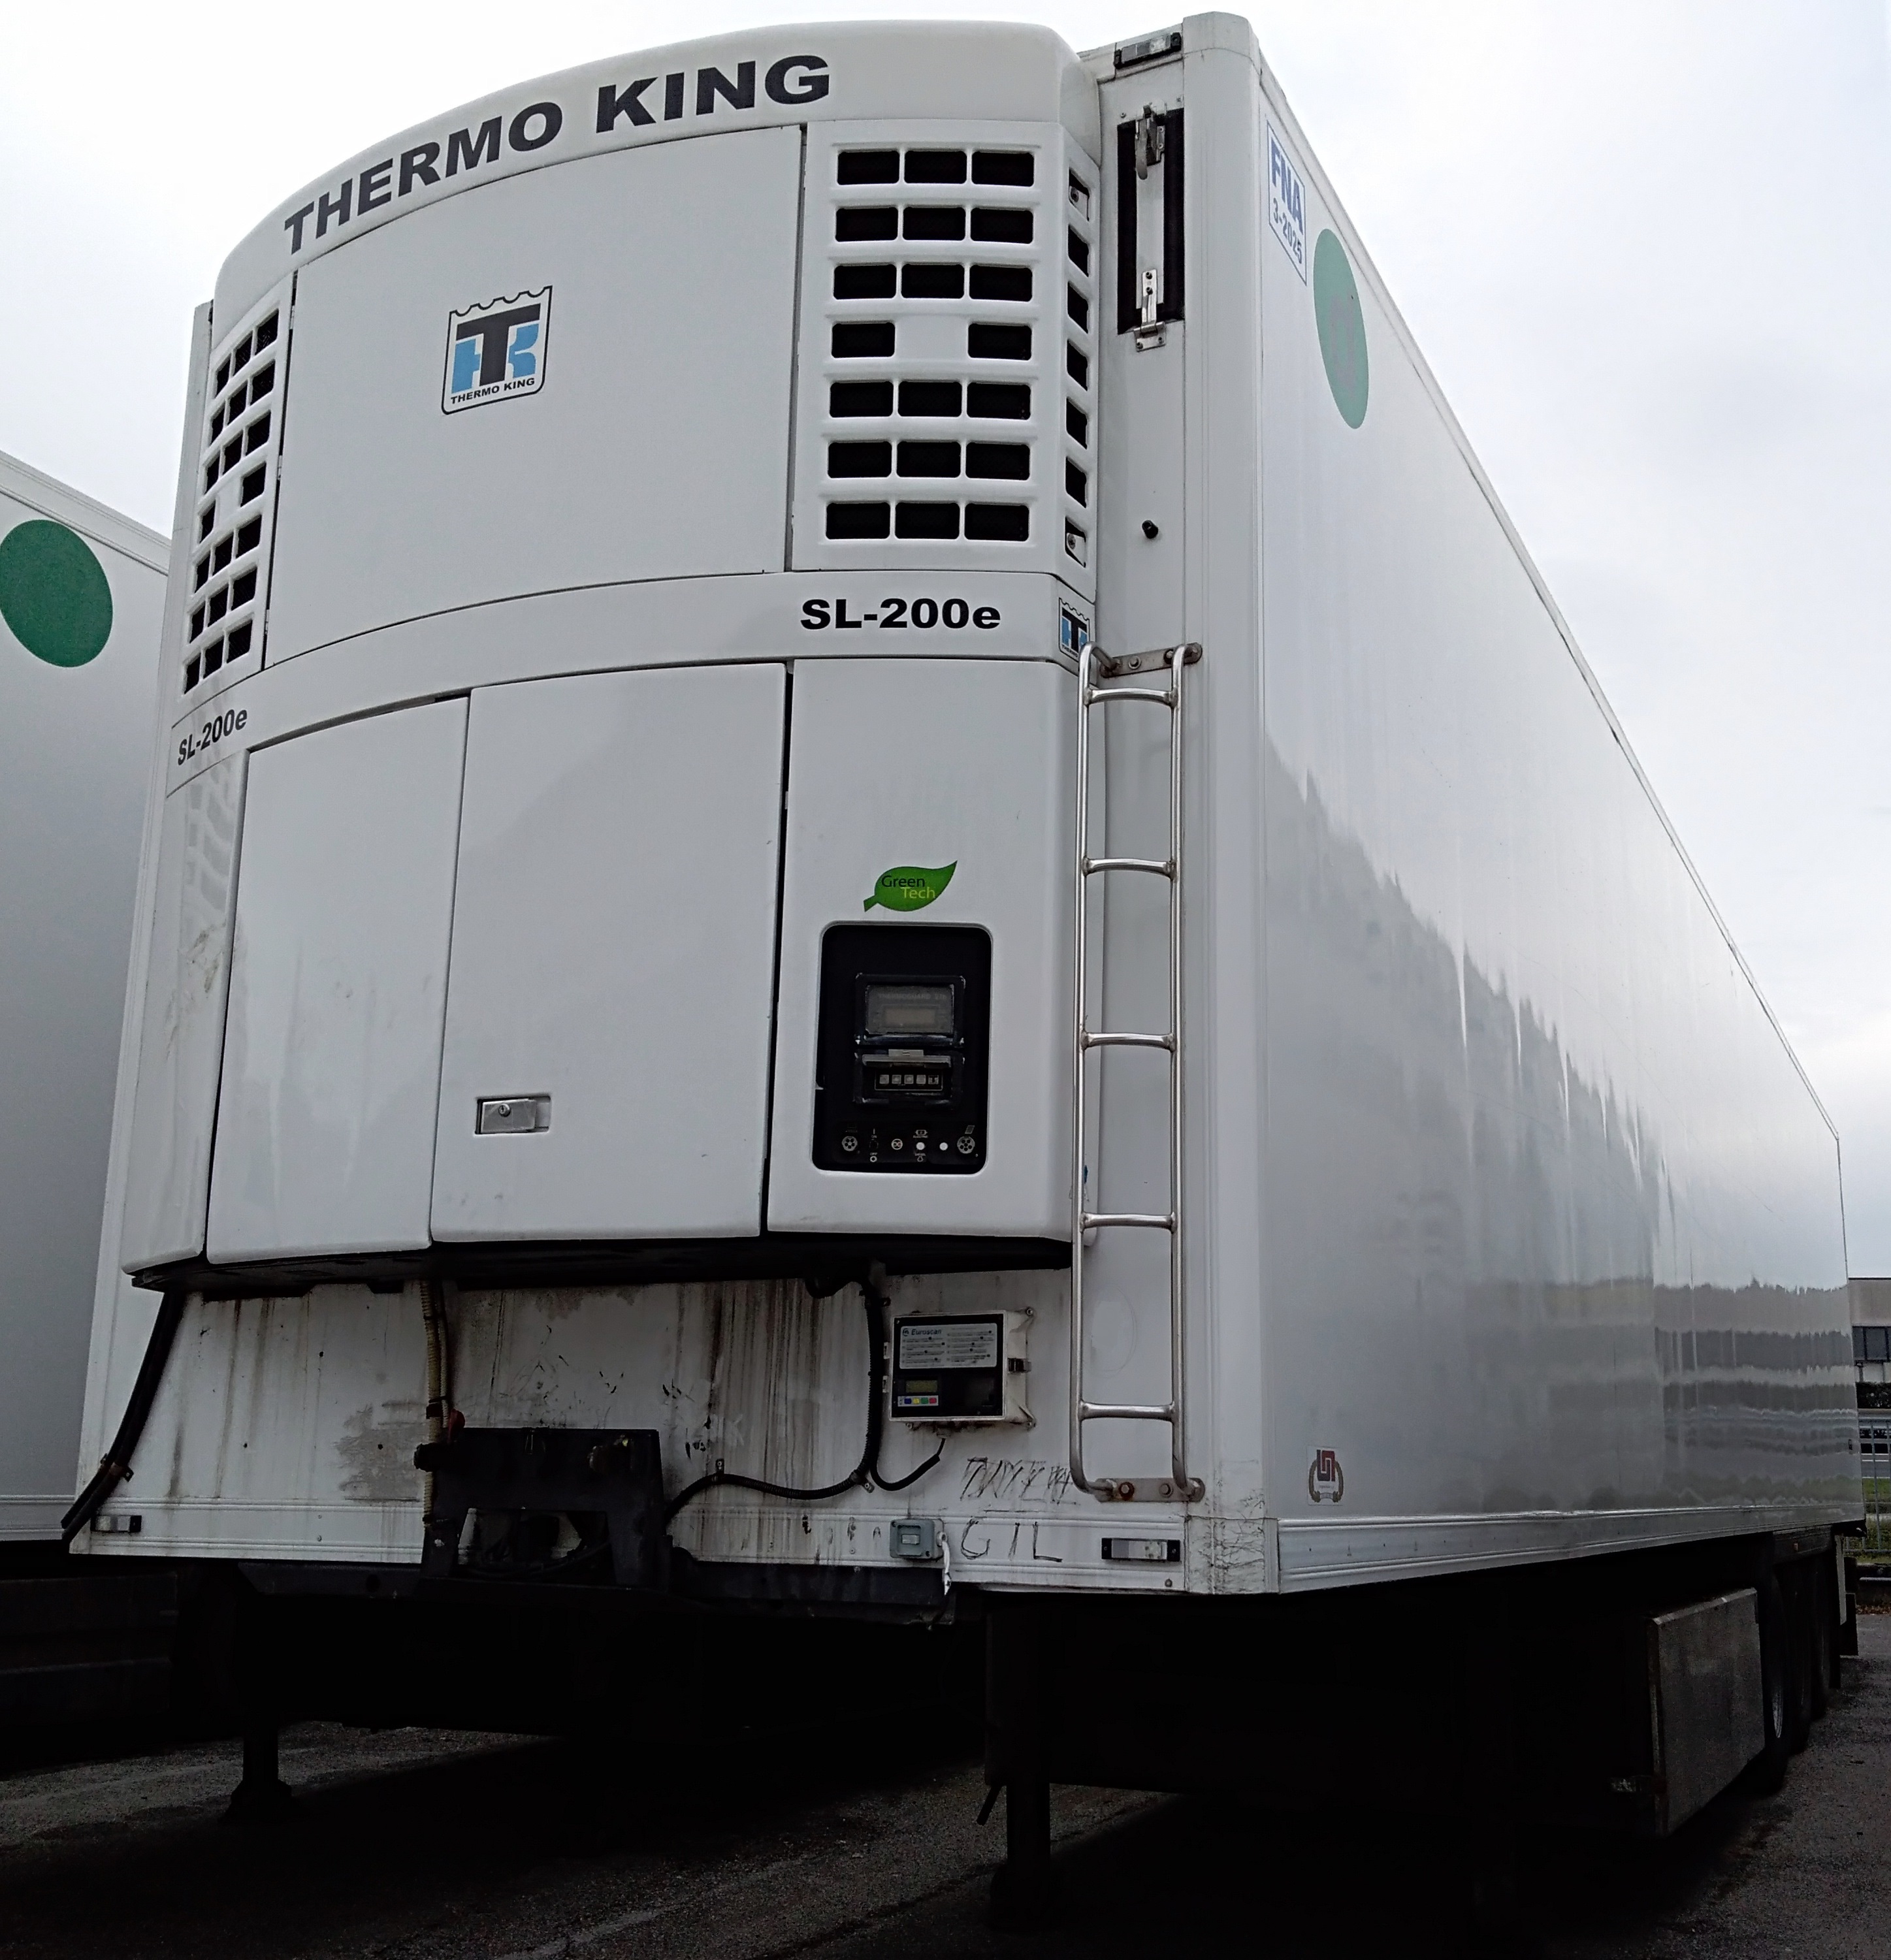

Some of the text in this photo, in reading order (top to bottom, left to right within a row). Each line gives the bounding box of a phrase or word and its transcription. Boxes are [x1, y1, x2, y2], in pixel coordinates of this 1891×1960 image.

[283, 54, 830, 255] THERMO KING
[1270, 137, 1304, 236] FNA
[450, 378, 536, 404] THERMO KING
[800, 598, 1001, 630] SL-200e
[178, 709, 248, 766] SL-200e
[881, 875, 926, 888] Green
[900, 886, 936, 899] Tech
